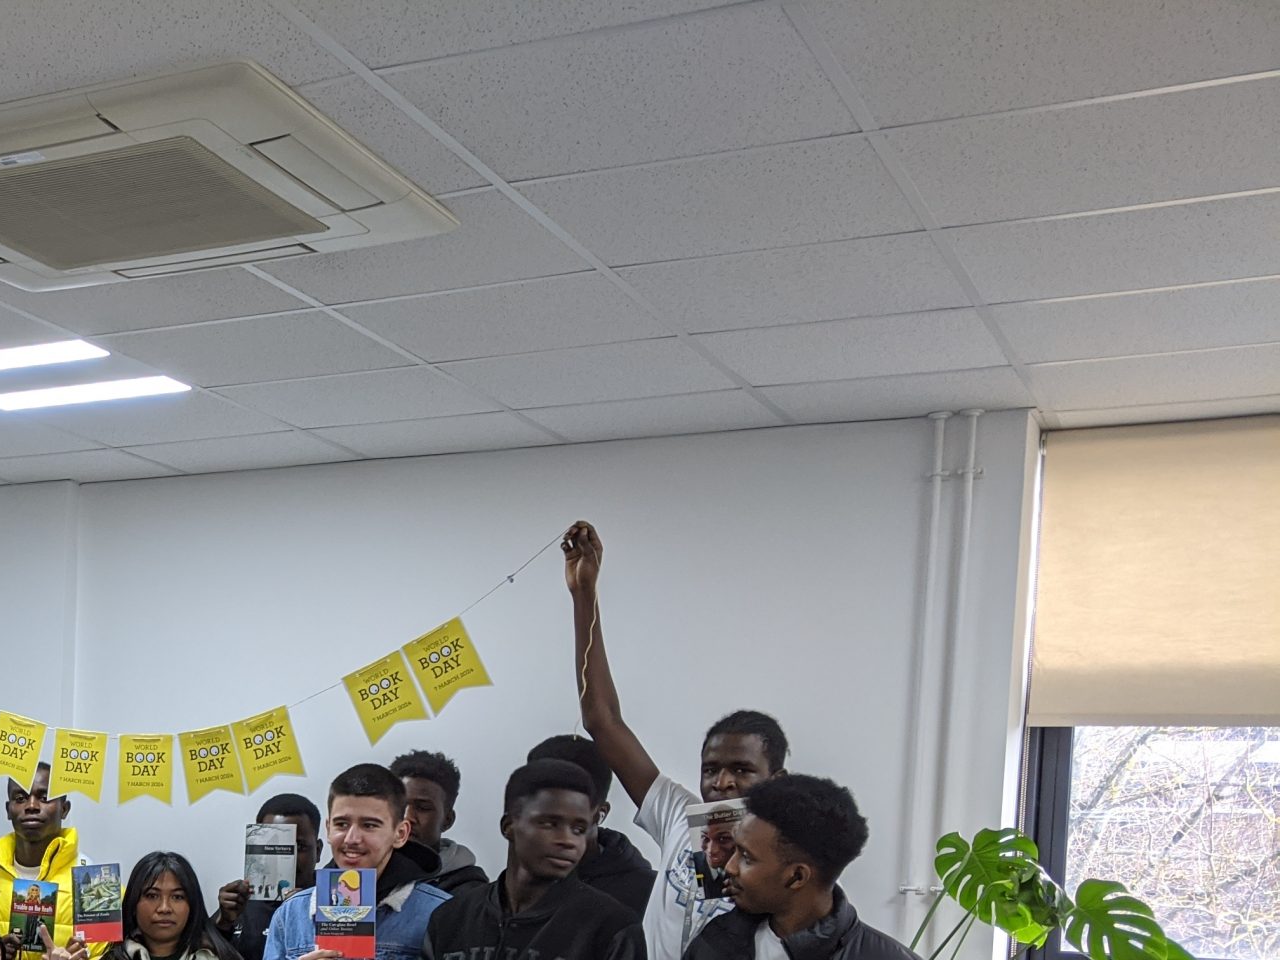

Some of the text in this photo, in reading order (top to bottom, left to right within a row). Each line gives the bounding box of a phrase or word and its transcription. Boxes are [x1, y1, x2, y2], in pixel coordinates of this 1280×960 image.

[423, 635, 449, 652] WORLD
[418, 638, 464, 670] BOOK
[431, 654, 461, 679] DAY
[363, 668, 389, 683] WORLD
[438, 675, 459, 690] MARCH
[460, 668, 474, 678] 2024
[358, 671, 403, 701] BOOK
[370, 687, 400, 710] DAY
[377, 707, 398, 721] MARCH
[398, 701, 412, 711] 2024
[11, 726, 31, 736] WORLD
[250, 722, 274, 733] WORLD
[0, 730, 36, 750] BOOK
[196, 737, 220, 746] WORLD
[244, 725, 286, 749] BOOK
[1, 744, 27, 760] DAY
[61, 747, 99, 762] BOOK
[126, 752, 165, 763] BOOK
[189, 743, 231, 761] BOOK
[253, 741, 283, 760] DAY
[16, 765, 27, 773] 2024
[65, 761, 92, 774] DAY
[198, 758, 225, 773] DAY
[257, 760, 278, 770] MARCH
[279, 756, 292, 764] 2024
[132, 765, 160, 777] DAY
[199, 776, 219, 784] MARCH
